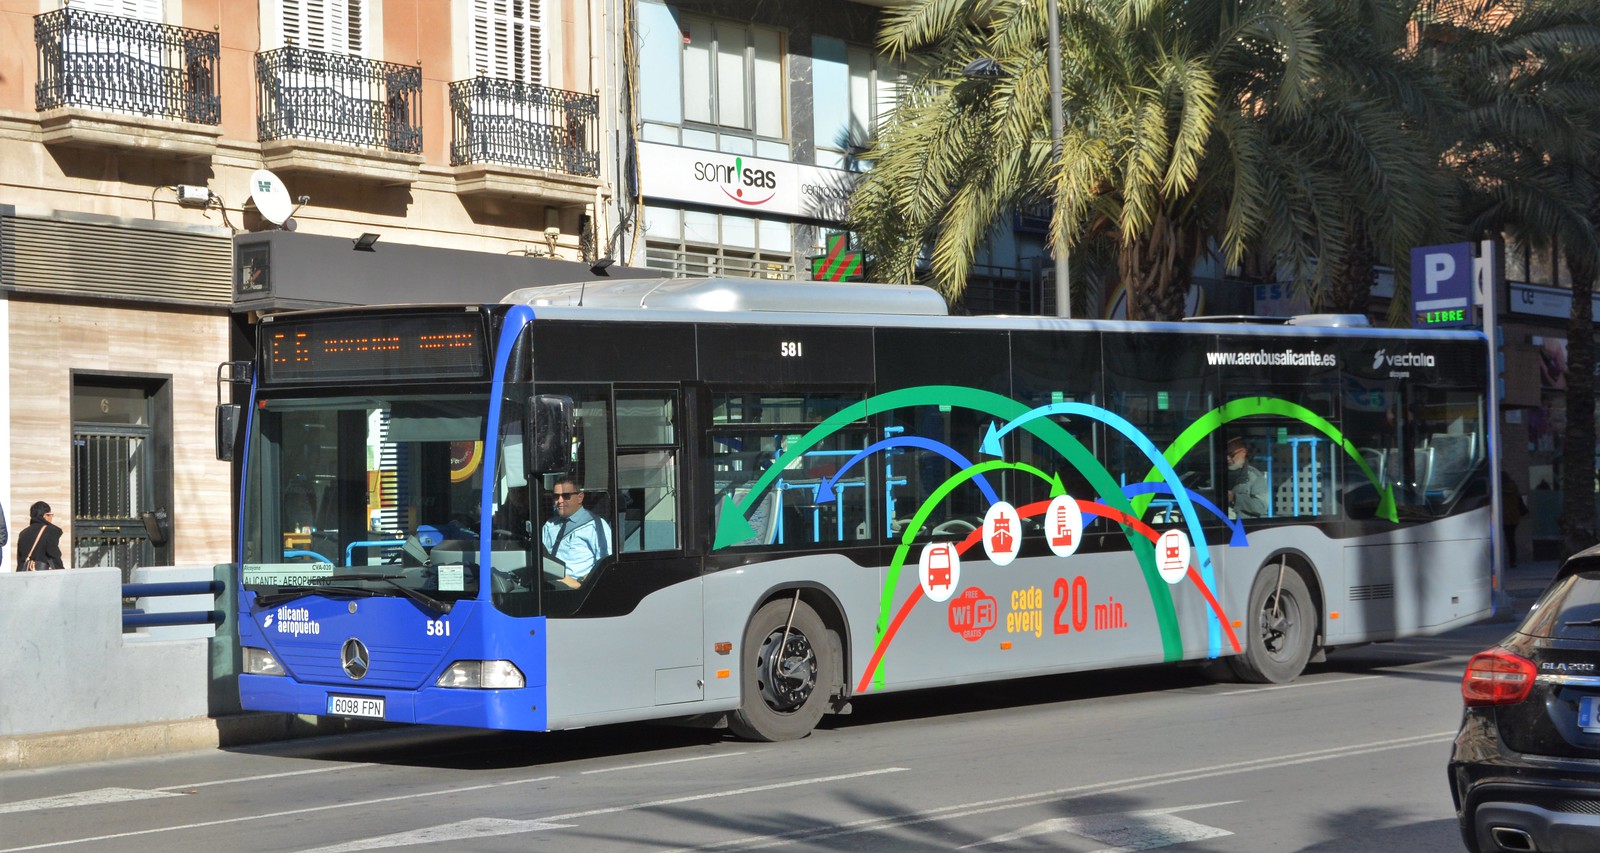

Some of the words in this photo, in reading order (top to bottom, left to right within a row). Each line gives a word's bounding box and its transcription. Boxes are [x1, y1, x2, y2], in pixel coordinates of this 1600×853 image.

[1425, 253, 1456, 294] P
[1427, 310, 1464, 323] LIBRE
[781, 341, 802, 357] 581
[1206, 349, 1336, 367] www.aerobusalicante.es
[1386, 352, 1435, 367] vectalia
[100, 398, 109, 413] 6
[244, 576, 278, 586] ALICANTE
[965, 590, 979, 599] FREE
[1011, 585, 1043, 611] cada
[277, 605, 309, 621] alicante
[1053, 575, 1088, 635] 20
[1094, 596, 1128, 630] min.
[277, 620, 320, 637] aeropuerto
[426, 620, 450, 636] 581
[1007, 609, 1043, 638] every
[963, 629, 982, 638] GRATIS
[1542, 662, 1567, 671] GLA
[1568, 663, 1595, 671] 200
[335, 699, 359, 714] 6098
[362, 701, 381, 716] FPN
